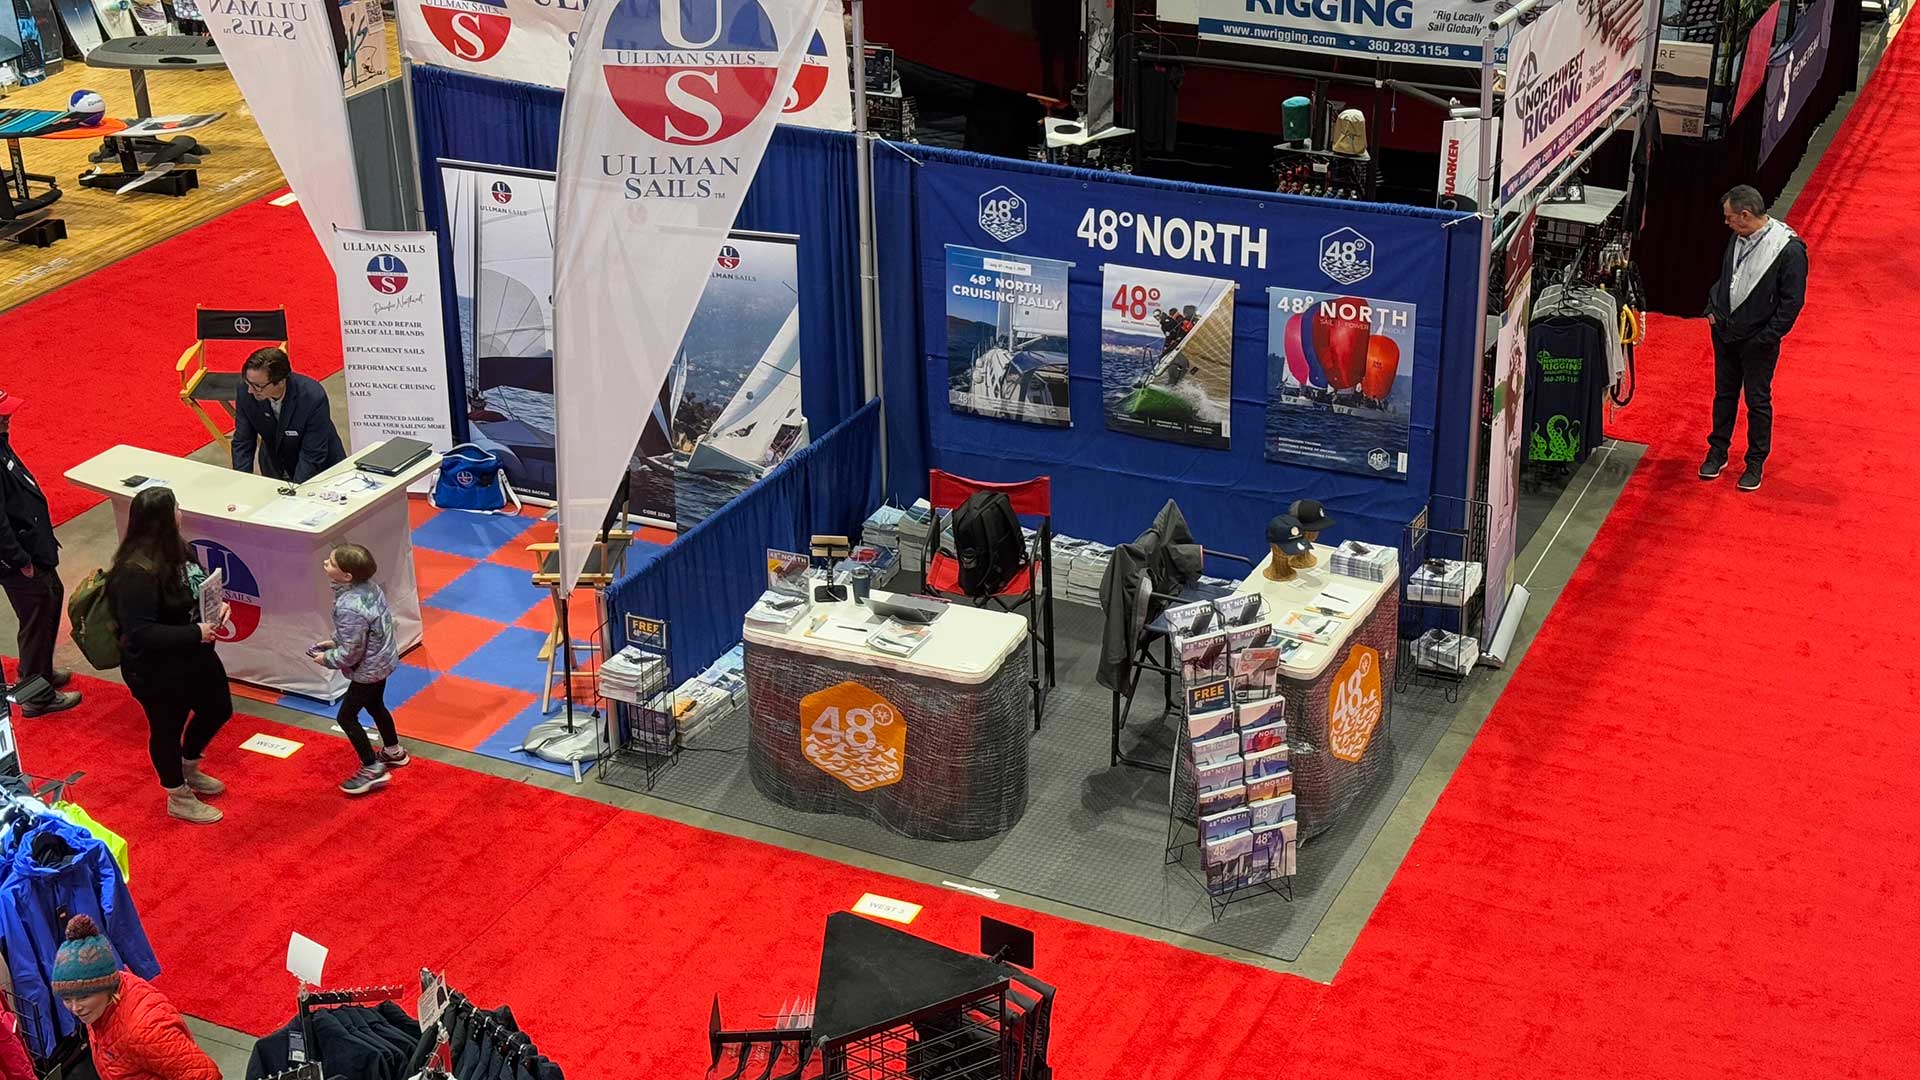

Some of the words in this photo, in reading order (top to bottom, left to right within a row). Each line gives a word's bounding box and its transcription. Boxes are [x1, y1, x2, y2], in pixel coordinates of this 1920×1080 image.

[1453, 12, 1485, 24] Locally
[1427, 22, 1445, 32] Sail
[1223, 22, 1337, 46] www.nwrigging.com
[1367, 39, 1450, 57] 360.293.1154
[617, 51, 699, 65] ULLMAN
[704, 52, 756, 66] SAILS
[1525, 48, 1585, 116] NORTHWEST
[1522, 71, 1583, 149] RIGGING
[600, 154, 740, 177] ULLMAN
[1445, 138, 1459, 198] HARKEN
[624, 177, 711, 200] SAILS
[480, 205, 507, 214] ULLMAN
[343, 242, 392, 252] ULLMAN
[394, 243, 426, 253] SAILS
[711, 272, 734, 280] LMAN
[995, 277, 1042, 295] NORTH
[952, 284, 1015, 304] CRUISING
[1018, 294, 1063, 311] RALLY
[1320, 301, 1408, 327] NORTH
[343, 319, 376, 327] SERVICE
[346, 346, 402, 354] REPLACEMENT
[403, 347, 425, 355] SAILS
[347, 364, 406, 372] PERFORMANCE
[406, 365, 428, 373] SAILS
[349, 381, 371, 389] LONG
[372, 382, 399, 390] RANGE
[399, 383, 436, 391] CRUISING
[1234, 595, 1259, 607] NORTH
[1185, 606, 1212, 617] NORTH
[632, 620, 660, 632] FREE
[1246, 626, 1271, 637] NORTH
[1198, 636, 1225, 647] NORTH
[1194, 684, 1225, 701] FREE
[1215, 764, 1241, 774] NORTH
[1264, 777, 1290, 788] NORTH
[1221, 812, 1247, 824] NORTH
